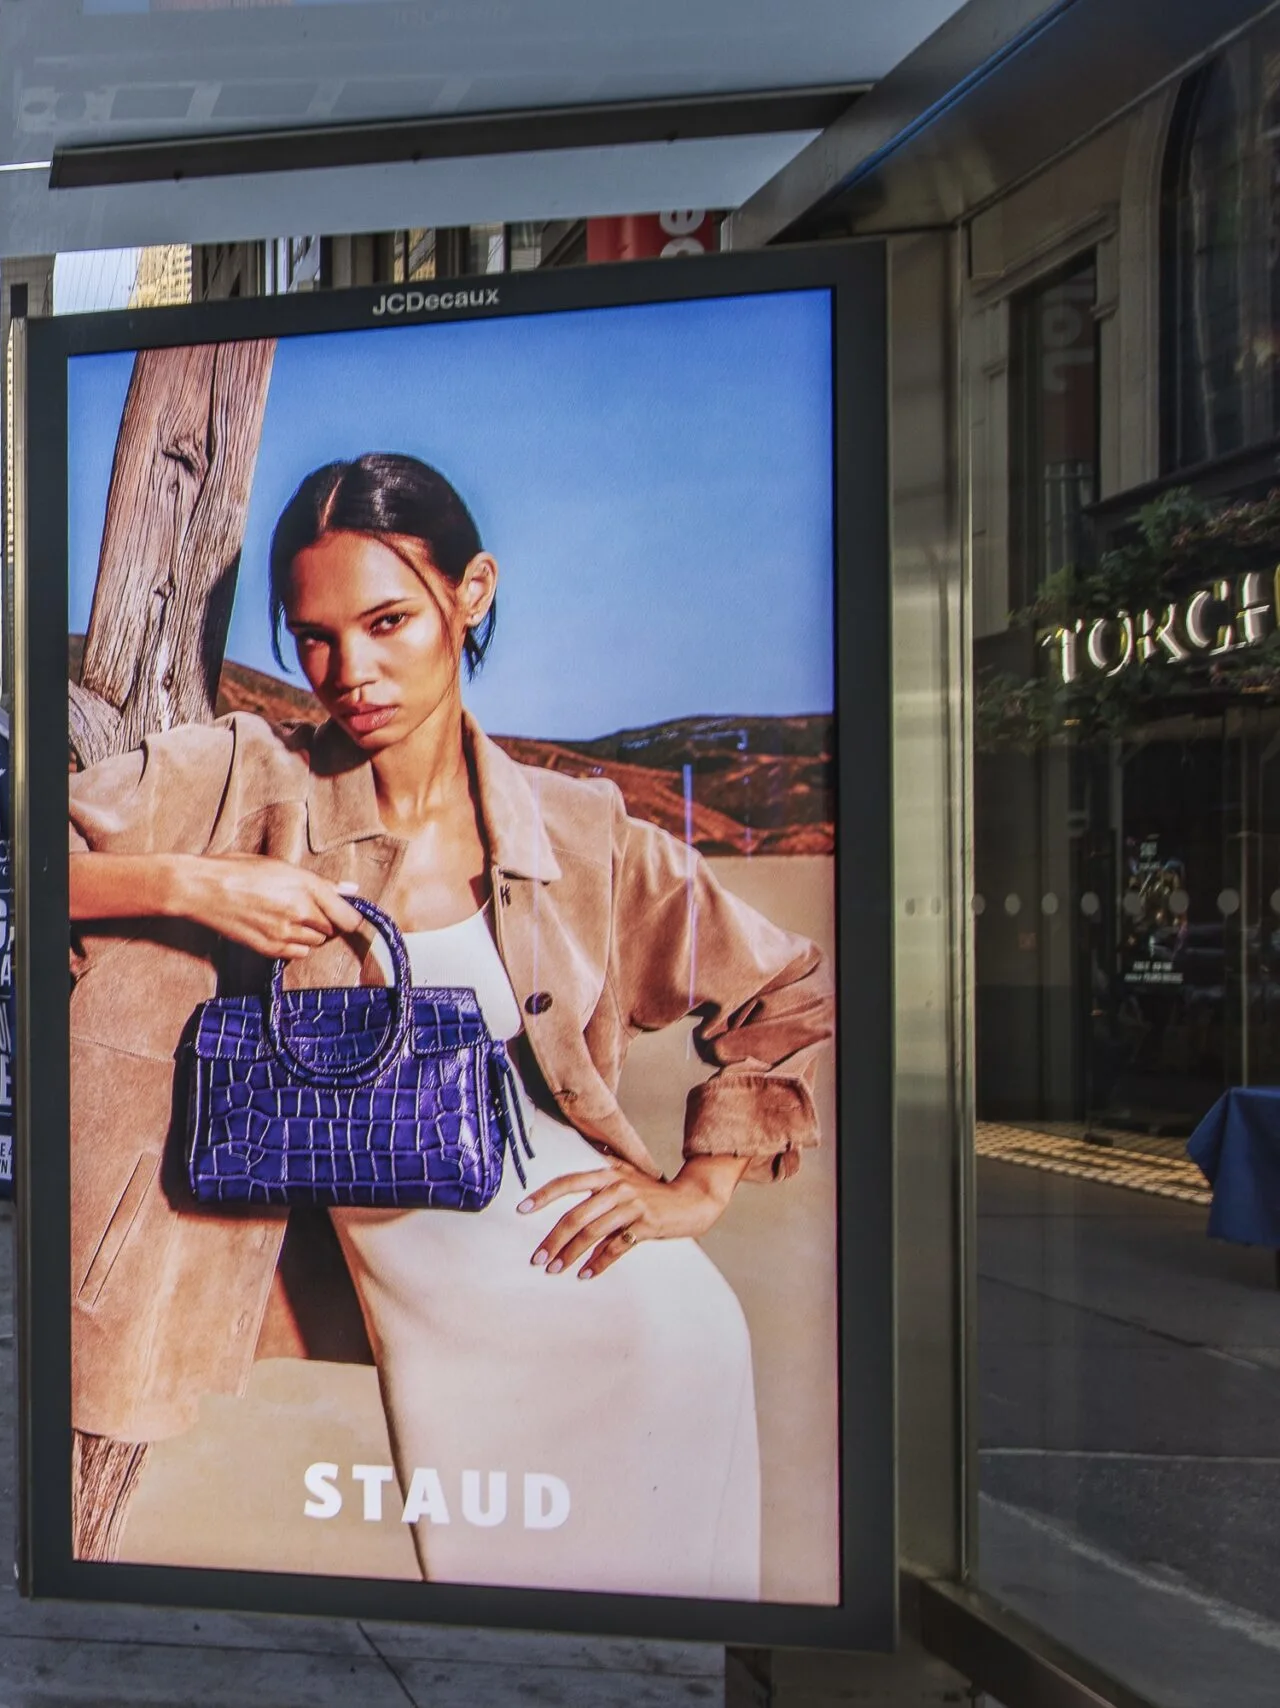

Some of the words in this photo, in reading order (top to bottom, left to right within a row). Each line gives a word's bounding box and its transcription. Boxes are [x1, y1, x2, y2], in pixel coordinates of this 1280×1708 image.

[372, 288, 499, 316] JCDecaux
[0, 1142, 7, 1158] E
[303, 1461, 571, 1530] STAUD
